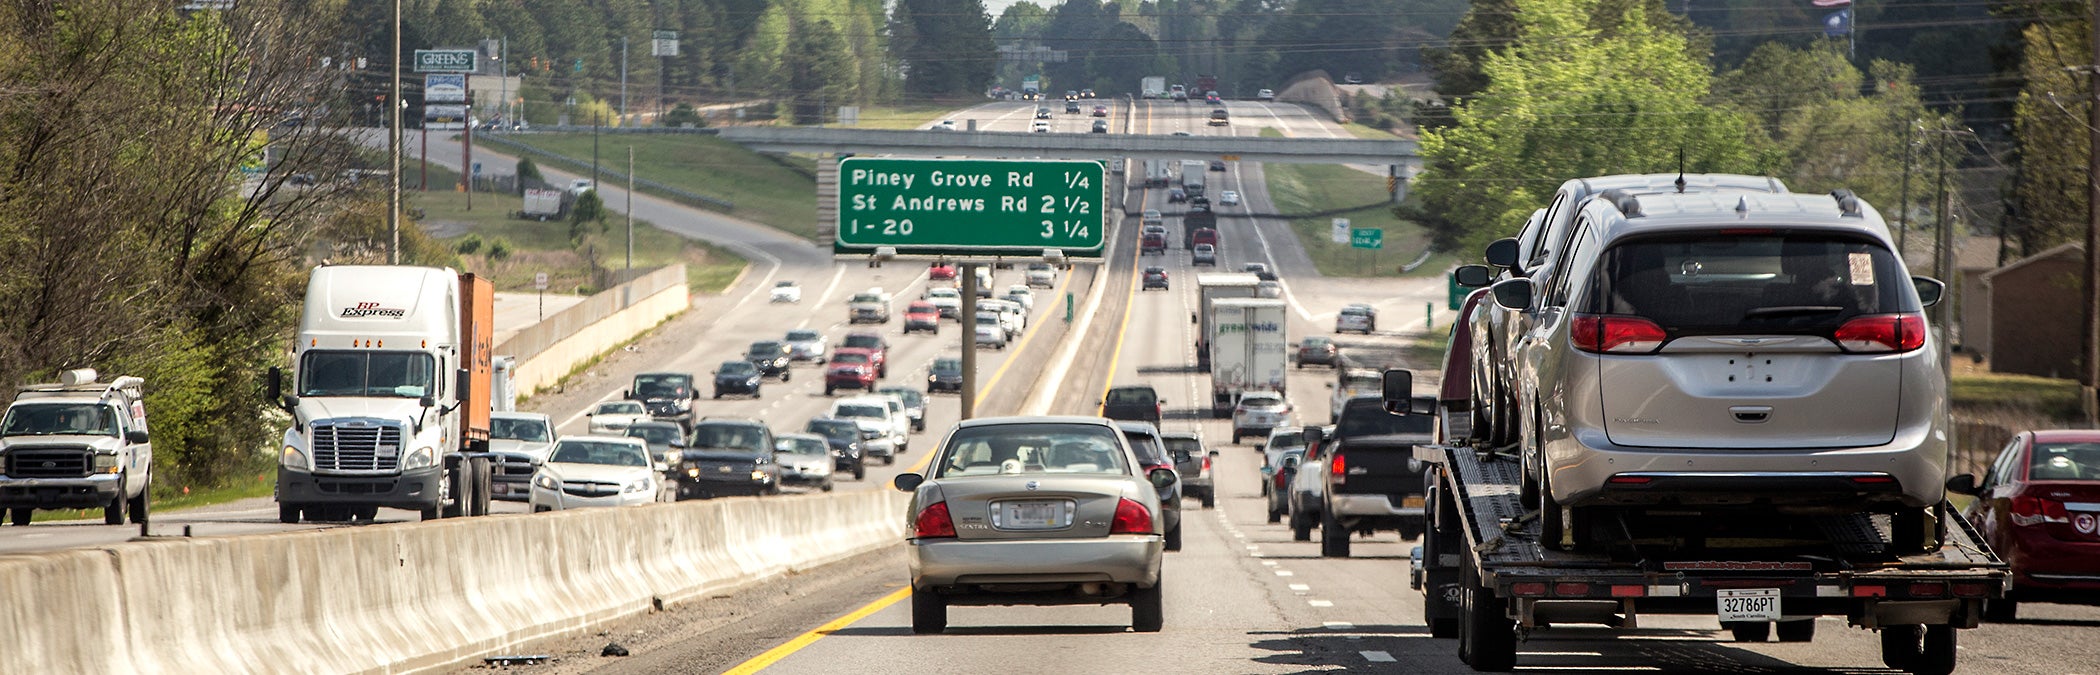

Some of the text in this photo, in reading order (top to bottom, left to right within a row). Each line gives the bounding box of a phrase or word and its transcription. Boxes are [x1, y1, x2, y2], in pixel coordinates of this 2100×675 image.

[422, 52, 468, 65] GREEN'S
[851, 169, 1090, 190] Piney Grove Rd 1/4
[851, 194, 1090, 214] St Andrews Rd 2 1/2
[1040, 220, 1054, 238] 3
[1063, 220, 1090, 239] 1/4
[342, 307, 405, 318] Express
[356, 302, 380, 310] BP
[1724, 597, 1775, 613] 32786PT
